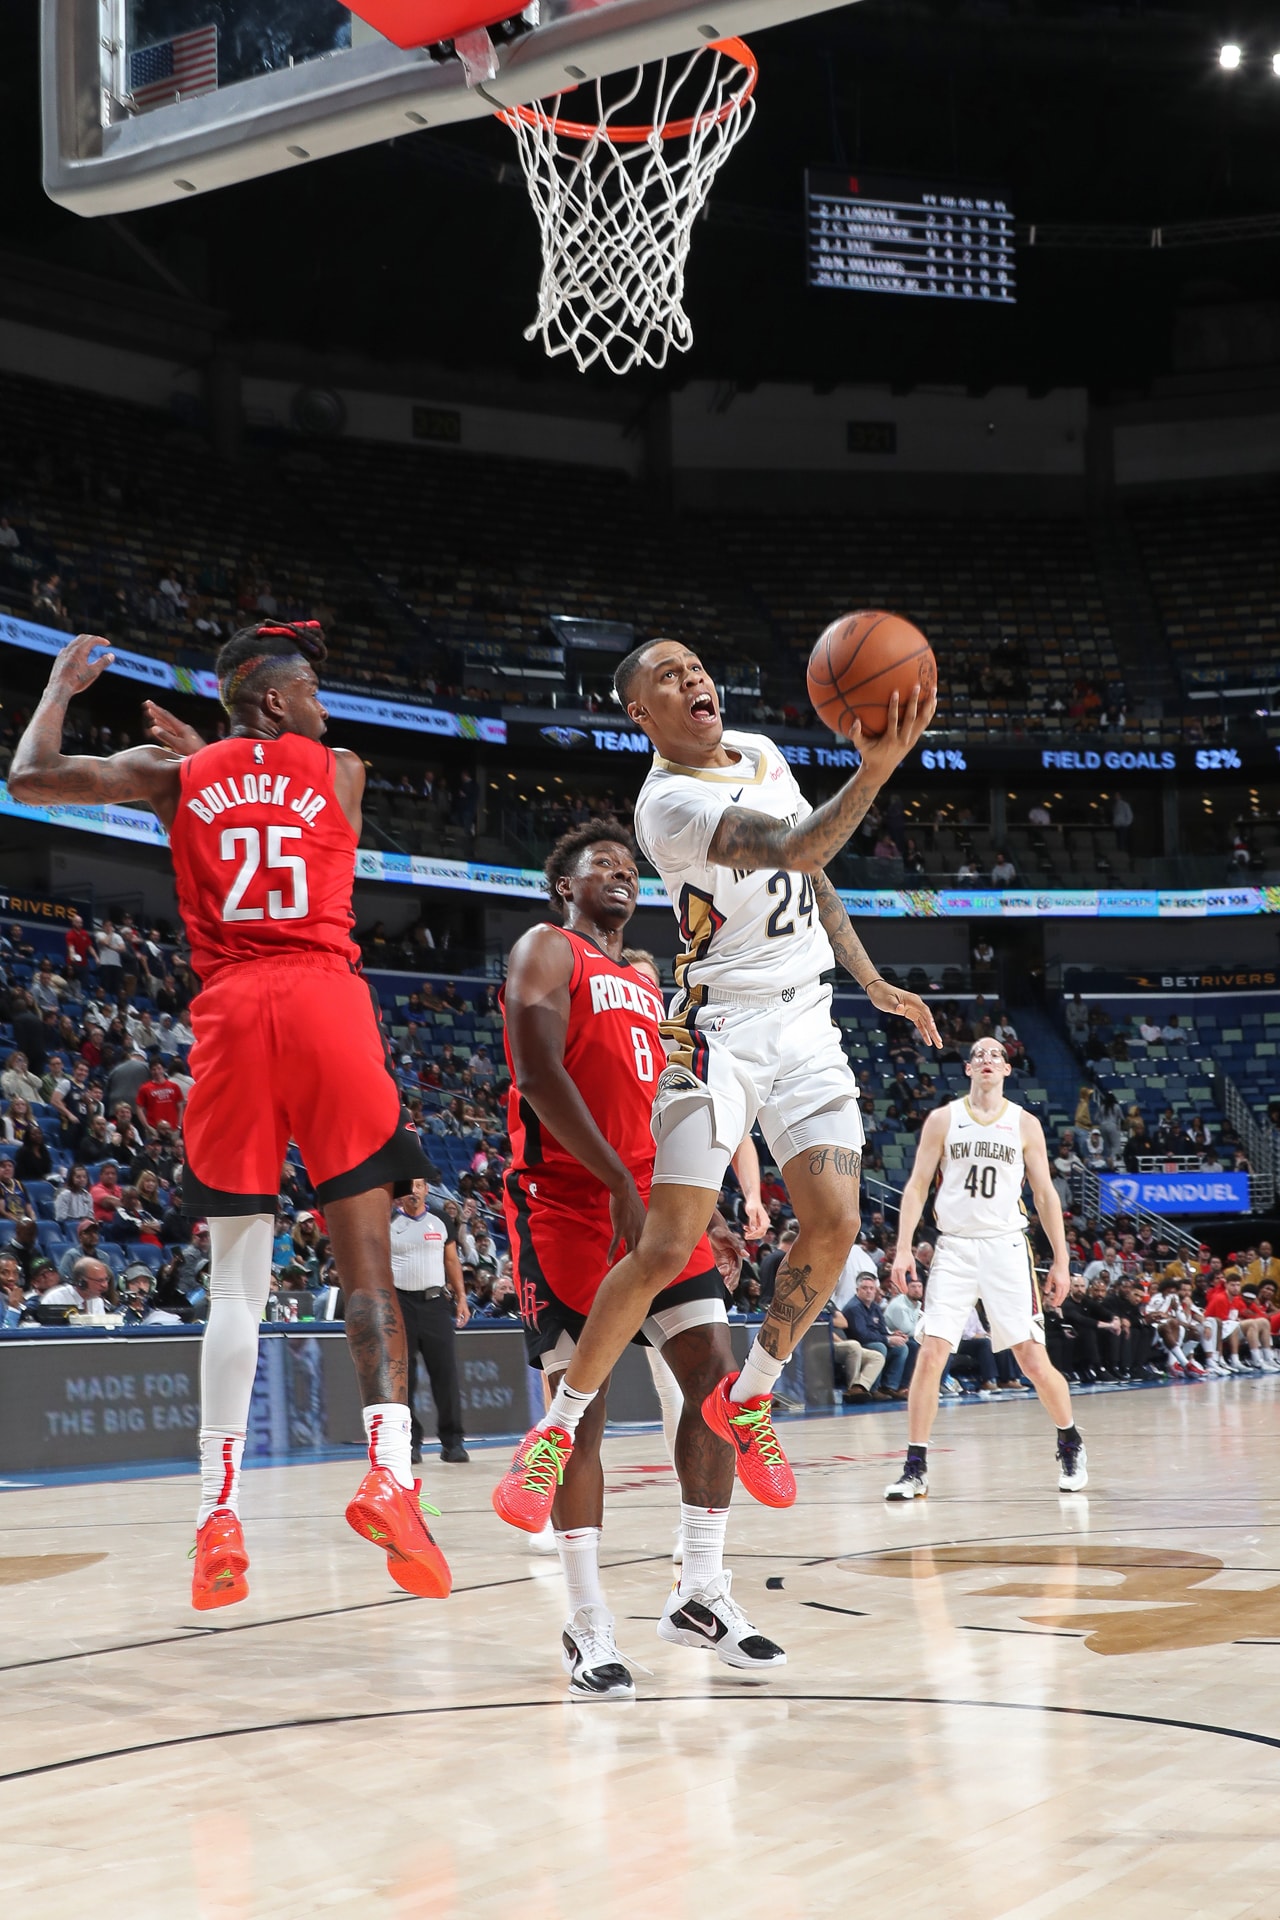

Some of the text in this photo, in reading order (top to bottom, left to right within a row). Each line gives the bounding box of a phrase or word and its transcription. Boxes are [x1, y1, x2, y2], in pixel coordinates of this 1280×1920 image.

[592, 729, 650, 754] TEAM
[921, 750, 967, 771] 61%
[1042, 749, 1242, 770] FIELD GOALS 52%
[187, 773, 327, 828] BULLOCK JR.
[220, 825, 310, 922] 25
[765, 869, 814, 940] 24
[1161, 973, 1276, 988] BETRIVERS
[630, 1025, 654, 1083] 8
[950, 1141, 1017, 1165] NEW ORLEANS
[964, 1164, 998, 1199] 40
[1142, 1183, 1240, 1203] FANDUEL
[463, 1360, 500, 1383] FOR
[65, 1372, 190, 1402] MADE FOR
[471, 1386, 514, 1409] EASY
[45, 1409, 96, 1437] THE
[103, 1405, 146, 1434] BIG
